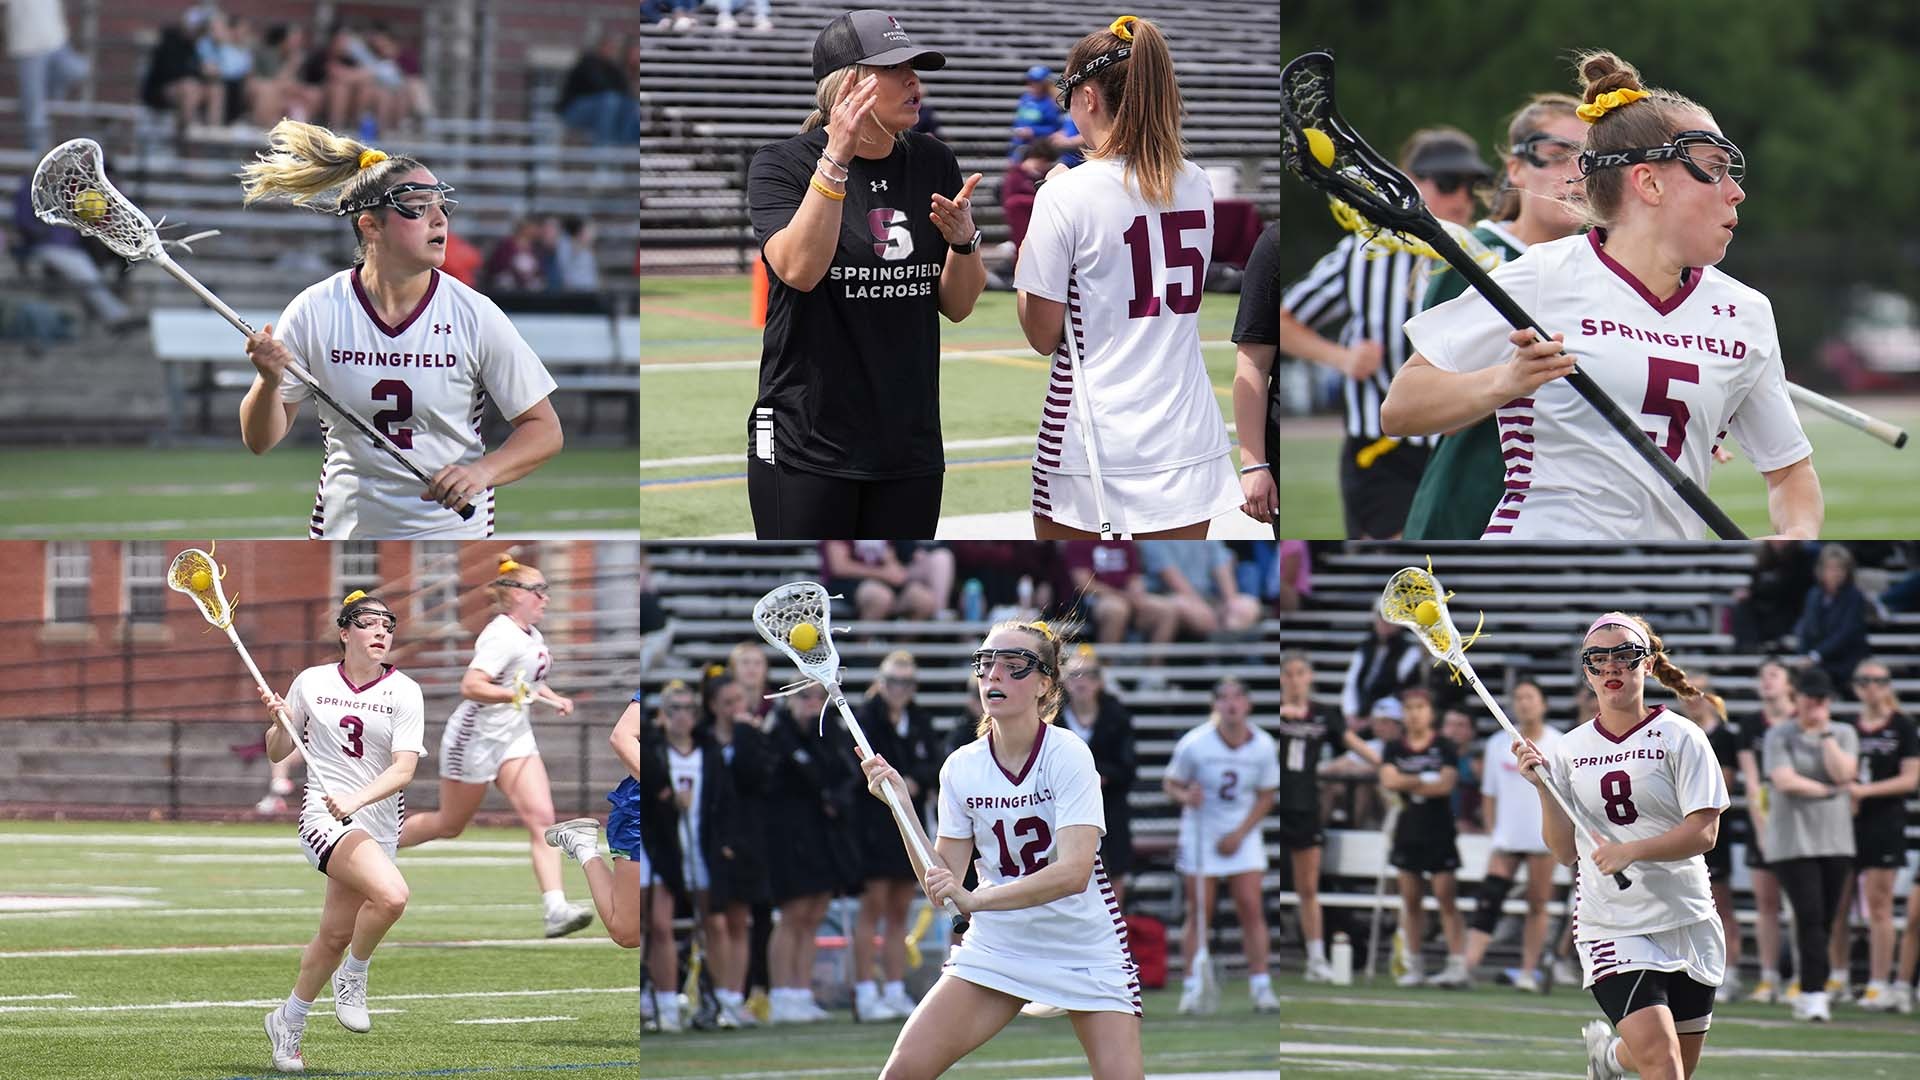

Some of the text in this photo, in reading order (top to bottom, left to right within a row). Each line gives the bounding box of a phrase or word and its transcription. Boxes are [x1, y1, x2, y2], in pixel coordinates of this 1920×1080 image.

[1086, 53, 1111, 72] STX
[1117, 47, 1132, 57] S
[1645, 147, 1677, 160] ST
[866, 208, 914, 261] S
[830, 263, 941, 281] SPRINGFIELD
[1123, 209, 1207, 319] 15
[845, 282, 931, 299] LACROSSE
[1581, 318, 1747, 360] SPRINGFIELD
[331, 349, 457, 368] SPRINGFIELD
[371, 379, 413, 450] 2
[1641, 356, 1700, 463] 5
[316, 696, 393, 714] SPRINGFIELD
[339, 715, 364, 759] 3
[1573, 749, 1665, 768] SPRINGFIELD
[1220, 771, 1239, 801] 2
[1600, 770, 1639, 826] 8
[992, 816, 1052, 877] 12
